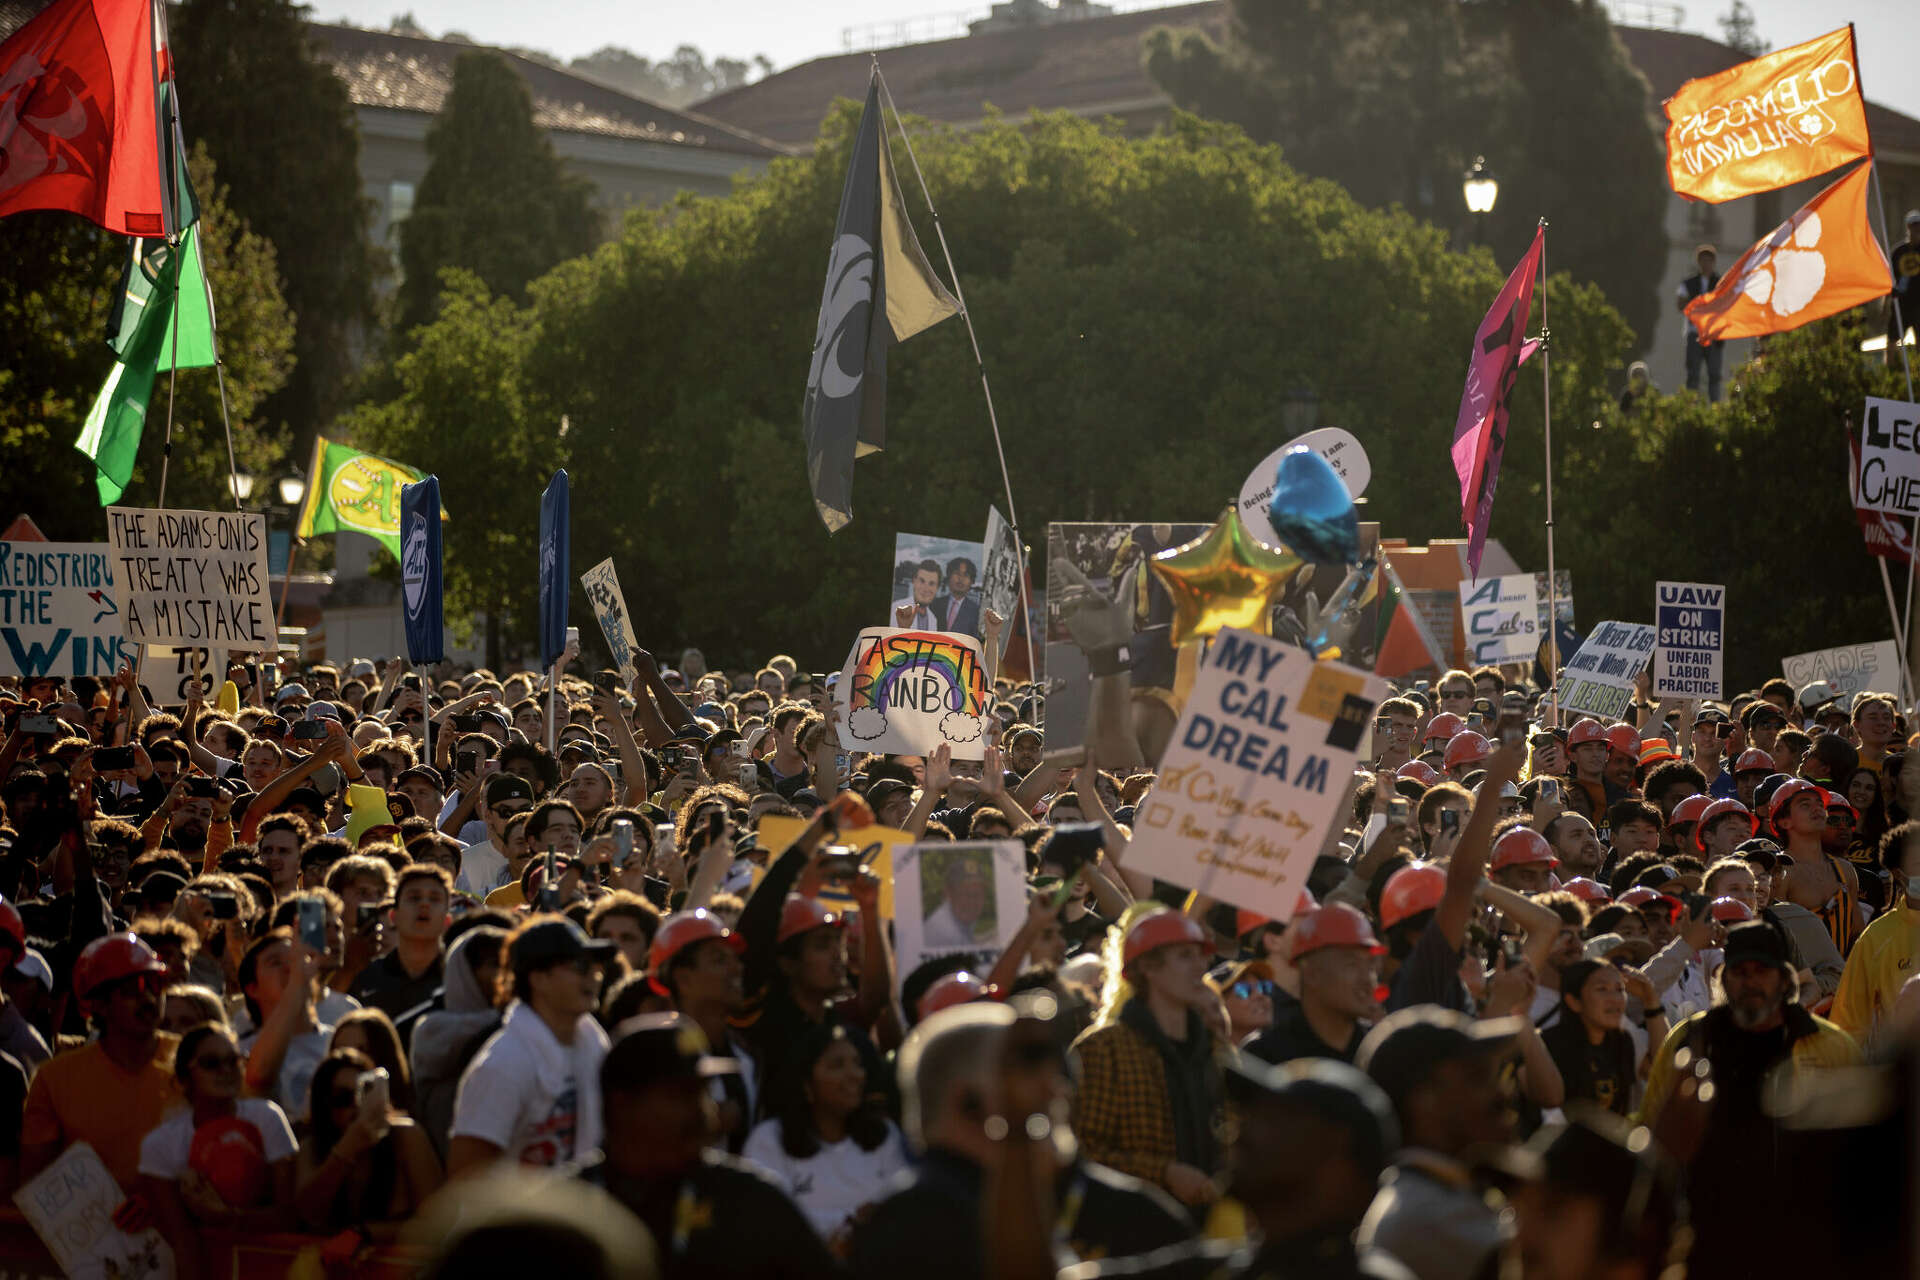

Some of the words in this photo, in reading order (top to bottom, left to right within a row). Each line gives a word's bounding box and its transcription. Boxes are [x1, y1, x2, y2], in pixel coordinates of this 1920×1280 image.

[111, 513, 149, 549] THE
[120, 557, 209, 594] TREATY
[217, 559, 260, 596] WAS
[0, 589, 53, 625] THE
[1660, 586, 1722, 606] UAW
[128, 599, 146, 637] A
[154, 599, 266, 642] MISTAKE
[1660, 627, 1719, 648] STRIKE
[1678, 610, 1703, 628] ON
[172, 647, 209, 674] TO
[854, 636, 951, 680] TASTE
[1214, 634, 1286, 683] MY
[1666, 650, 1712, 666] UNFAIR
[1668, 665, 1710, 680] LABOR
[1786, 644, 1879, 688] CADE
[851, 673, 995, 717] RAINBOW
[1569, 680, 1634, 719] BEARS!
[1658, 678, 1719, 694] PRACTICE
[1219, 680, 1289, 732] CAL
[1182, 713, 1330, 795] DREAM
